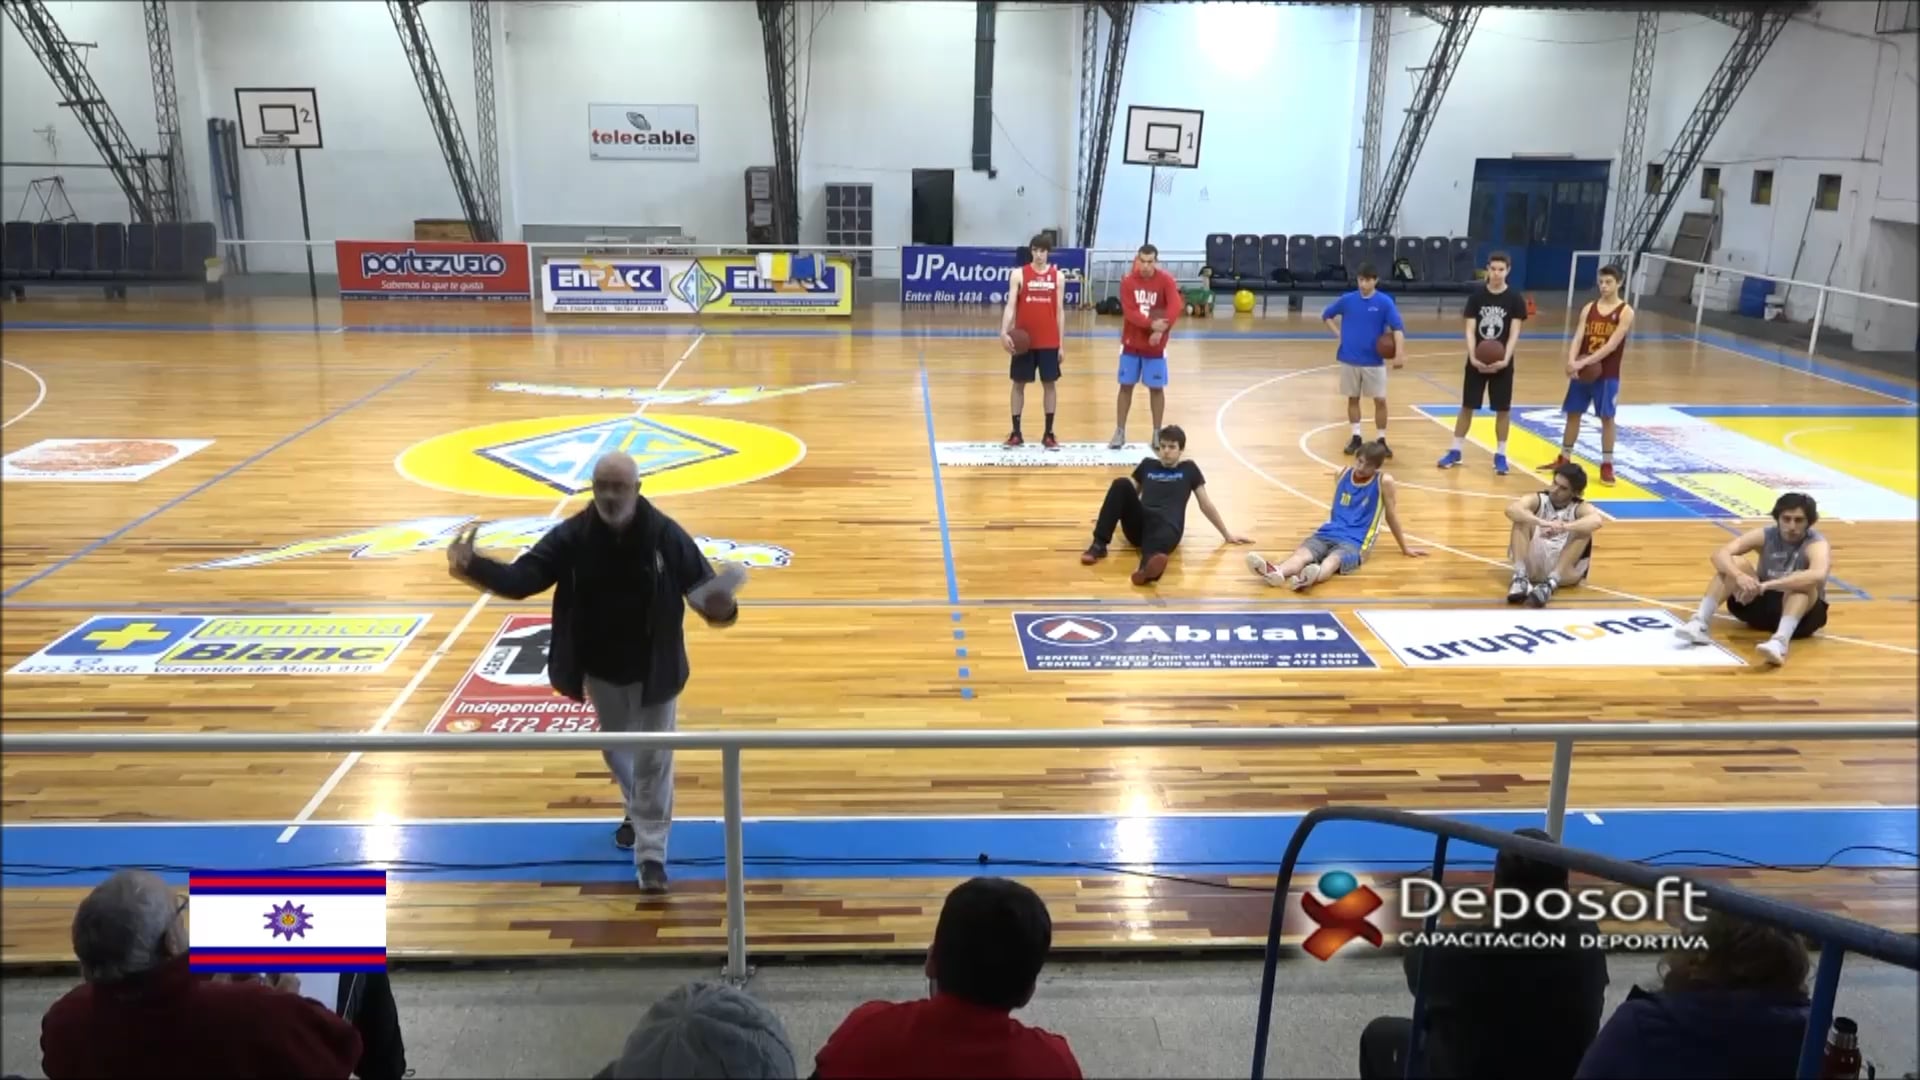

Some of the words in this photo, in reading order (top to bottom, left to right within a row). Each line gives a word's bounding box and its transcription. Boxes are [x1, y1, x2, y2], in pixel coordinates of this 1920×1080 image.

[299, 107, 313, 123] 2
[591, 129, 696, 145] telecable
[1186, 131, 1194, 149] 1
[906, 254, 945, 281] JP
[381, 280, 420, 290] Sabemos
[421, 280, 431, 290] lo
[432, 281, 449, 292] que
[450, 281, 459, 290] te
[460, 281, 485, 292] gusta
[905, 290, 932, 302] Entre
[958, 291, 983, 302] 1434
[209, 618, 403, 636] farmacia
[1125, 624, 1340, 643] Abitab
[1403, 615, 1674, 661] uruphone
[170, 642, 386, 661] Blanc
[248, 665, 274, 673] de
[491, 716, 541, 733] 472
[546, 716, 602, 733] 252
